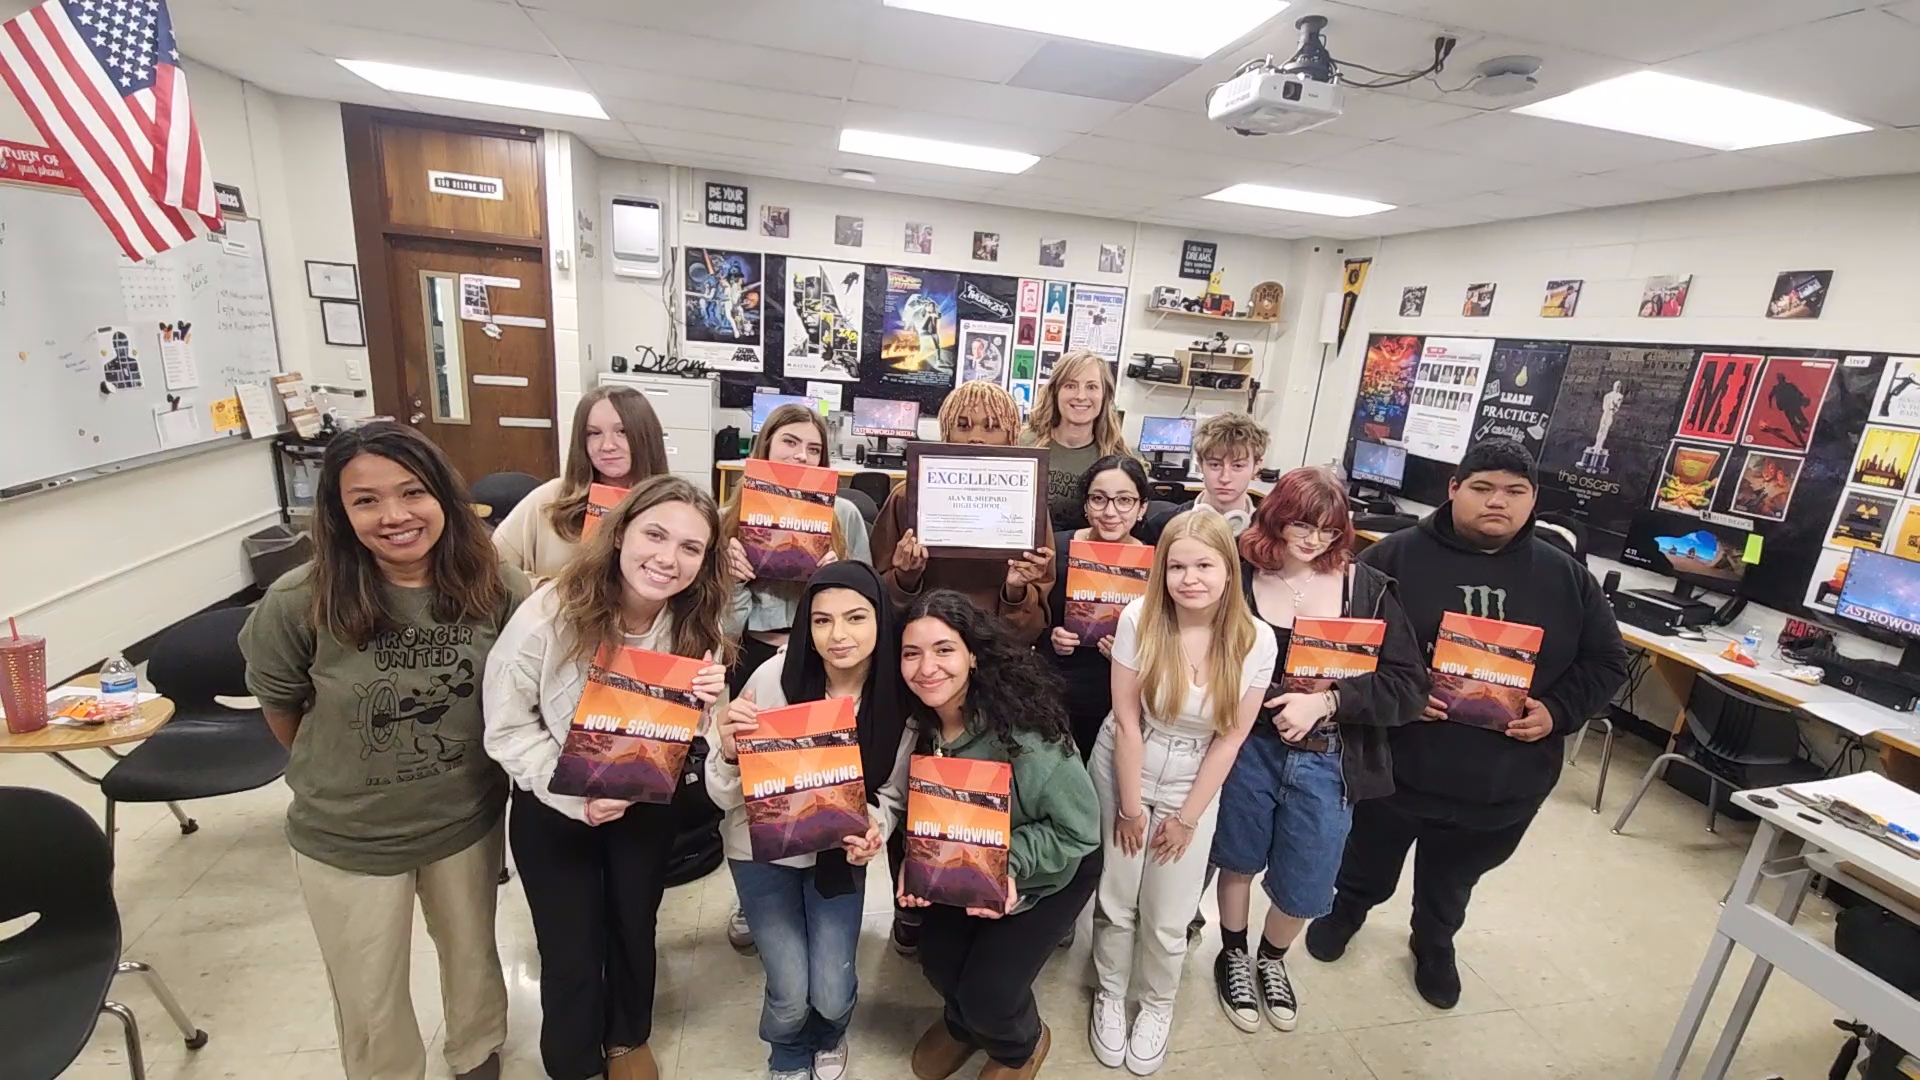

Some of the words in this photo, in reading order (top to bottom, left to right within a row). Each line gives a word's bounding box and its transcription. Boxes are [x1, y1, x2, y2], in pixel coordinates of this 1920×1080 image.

[709, 186, 722, 199] BE
[723, 187, 744, 202] YOUR
[635, 345, 706, 372] Dream
[731, 354, 761, 363] WARS
[1500, 392, 1533, 406] LEARN
[1482, 405, 1539, 423] PRACTICE
[927, 471, 1029, 487] EXCELLENCE
[1558, 469, 1577, 484] the
[1579, 477, 1620, 494] oscars
[747, 513, 774, 527] NOW
[778, 516, 829, 532] SHOWING
[1072, 589, 1096, 602] NOW
[1101, 591, 1141, 604] SHOWIN
[374, 647, 458, 672] UNITED
[1293, 666, 1318, 677] NOW
[1440, 661, 1468, 676] NOW
[1472, 667, 1528, 688] SHOWING
[583, 714, 621, 732] NOW
[625, 719, 691, 741] SHOWING
[754, 777, 786, 799] NOW
[794, 764, 858, 790] SHOWING
[914, 821, 940, 837] NOW
[947, 824, 1003, 845] SHOWING
